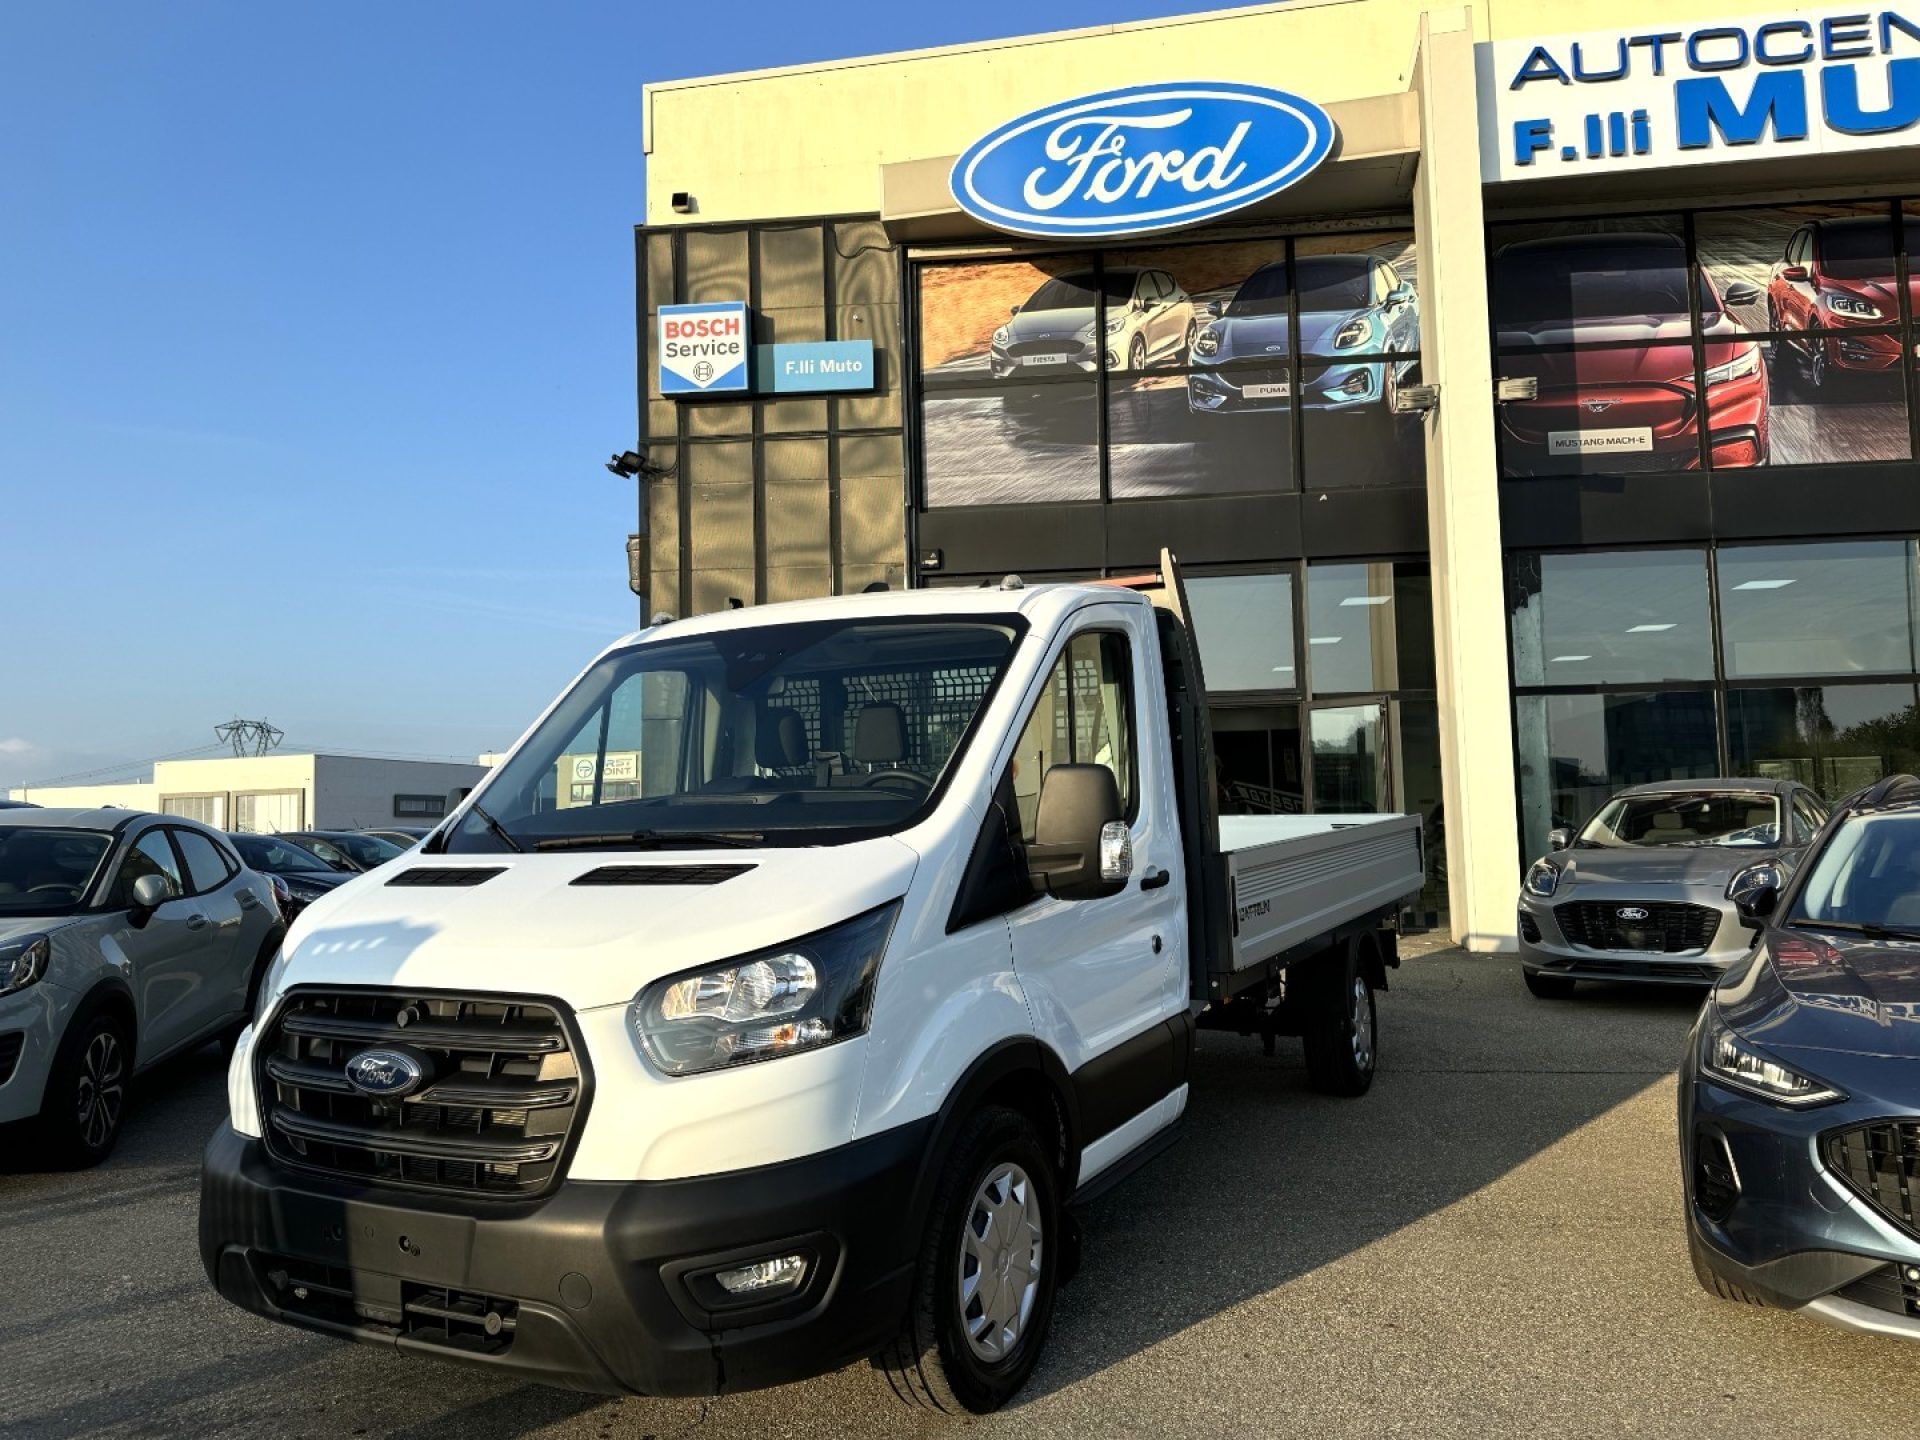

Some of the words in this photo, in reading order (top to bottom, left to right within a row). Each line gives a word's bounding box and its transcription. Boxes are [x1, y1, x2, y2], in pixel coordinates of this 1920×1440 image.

[1513, 108, 1653, 166] F.lli
[1674, 57, 1920, 150] MU
[1023, 107, 1252, 210] Ford
[664, 317, 740, 339] BOSCH
[665, 339, 741, 358] Service
[785, 360, 815, 375] F.lli
[819, 359, 863, 374] Muto
[1032, 355, 1056, 363] FIESTA
[1555, 438, 1605, 448] MUSTANG
[1606, 436, 1646, 446] MACH-E
[356, 1058, 398, 1085] Ford
